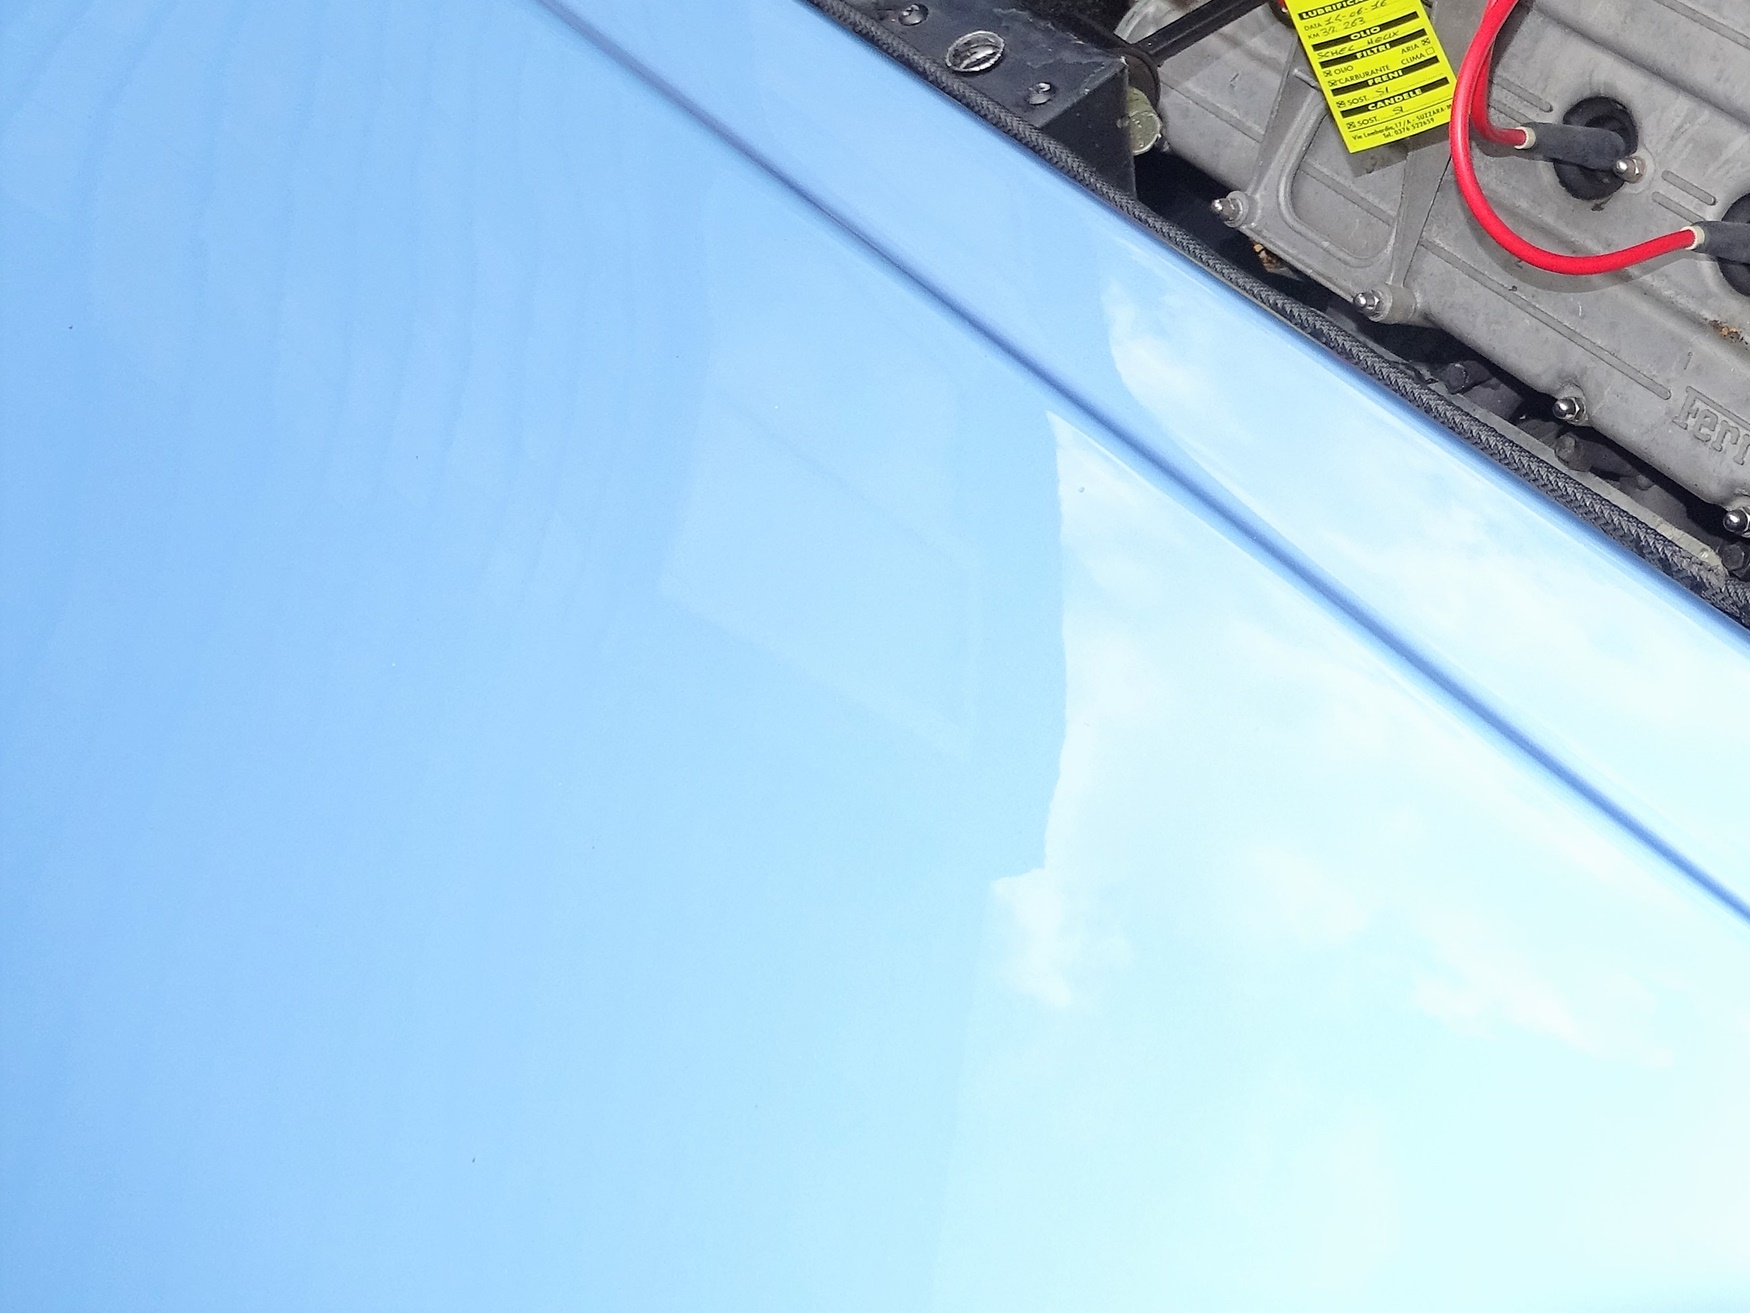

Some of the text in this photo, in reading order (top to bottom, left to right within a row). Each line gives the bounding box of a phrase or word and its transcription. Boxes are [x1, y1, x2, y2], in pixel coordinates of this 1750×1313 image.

[1304, 22, 1322, 31] DATA
[1308, 32, 1319, 40] KM
[1350, 26, 1381, 41] OLIO
[1355, 43, 1391, 60] FILTRI
[1401, 43, 1420, 55] ARIA
[1401, 52, 1426, 65] CLIMA
[1334, 65, 1354, 76] OLIO
[1337, 64, 1391, 85] CARBURANTE
[1368, 70, 1404, 86] FRENI
[1347, 94, 1370, 106] SOST.
[1367, 87, 1422, 111] CANDELE
[1357, 115, 1380, 126] SOST.
